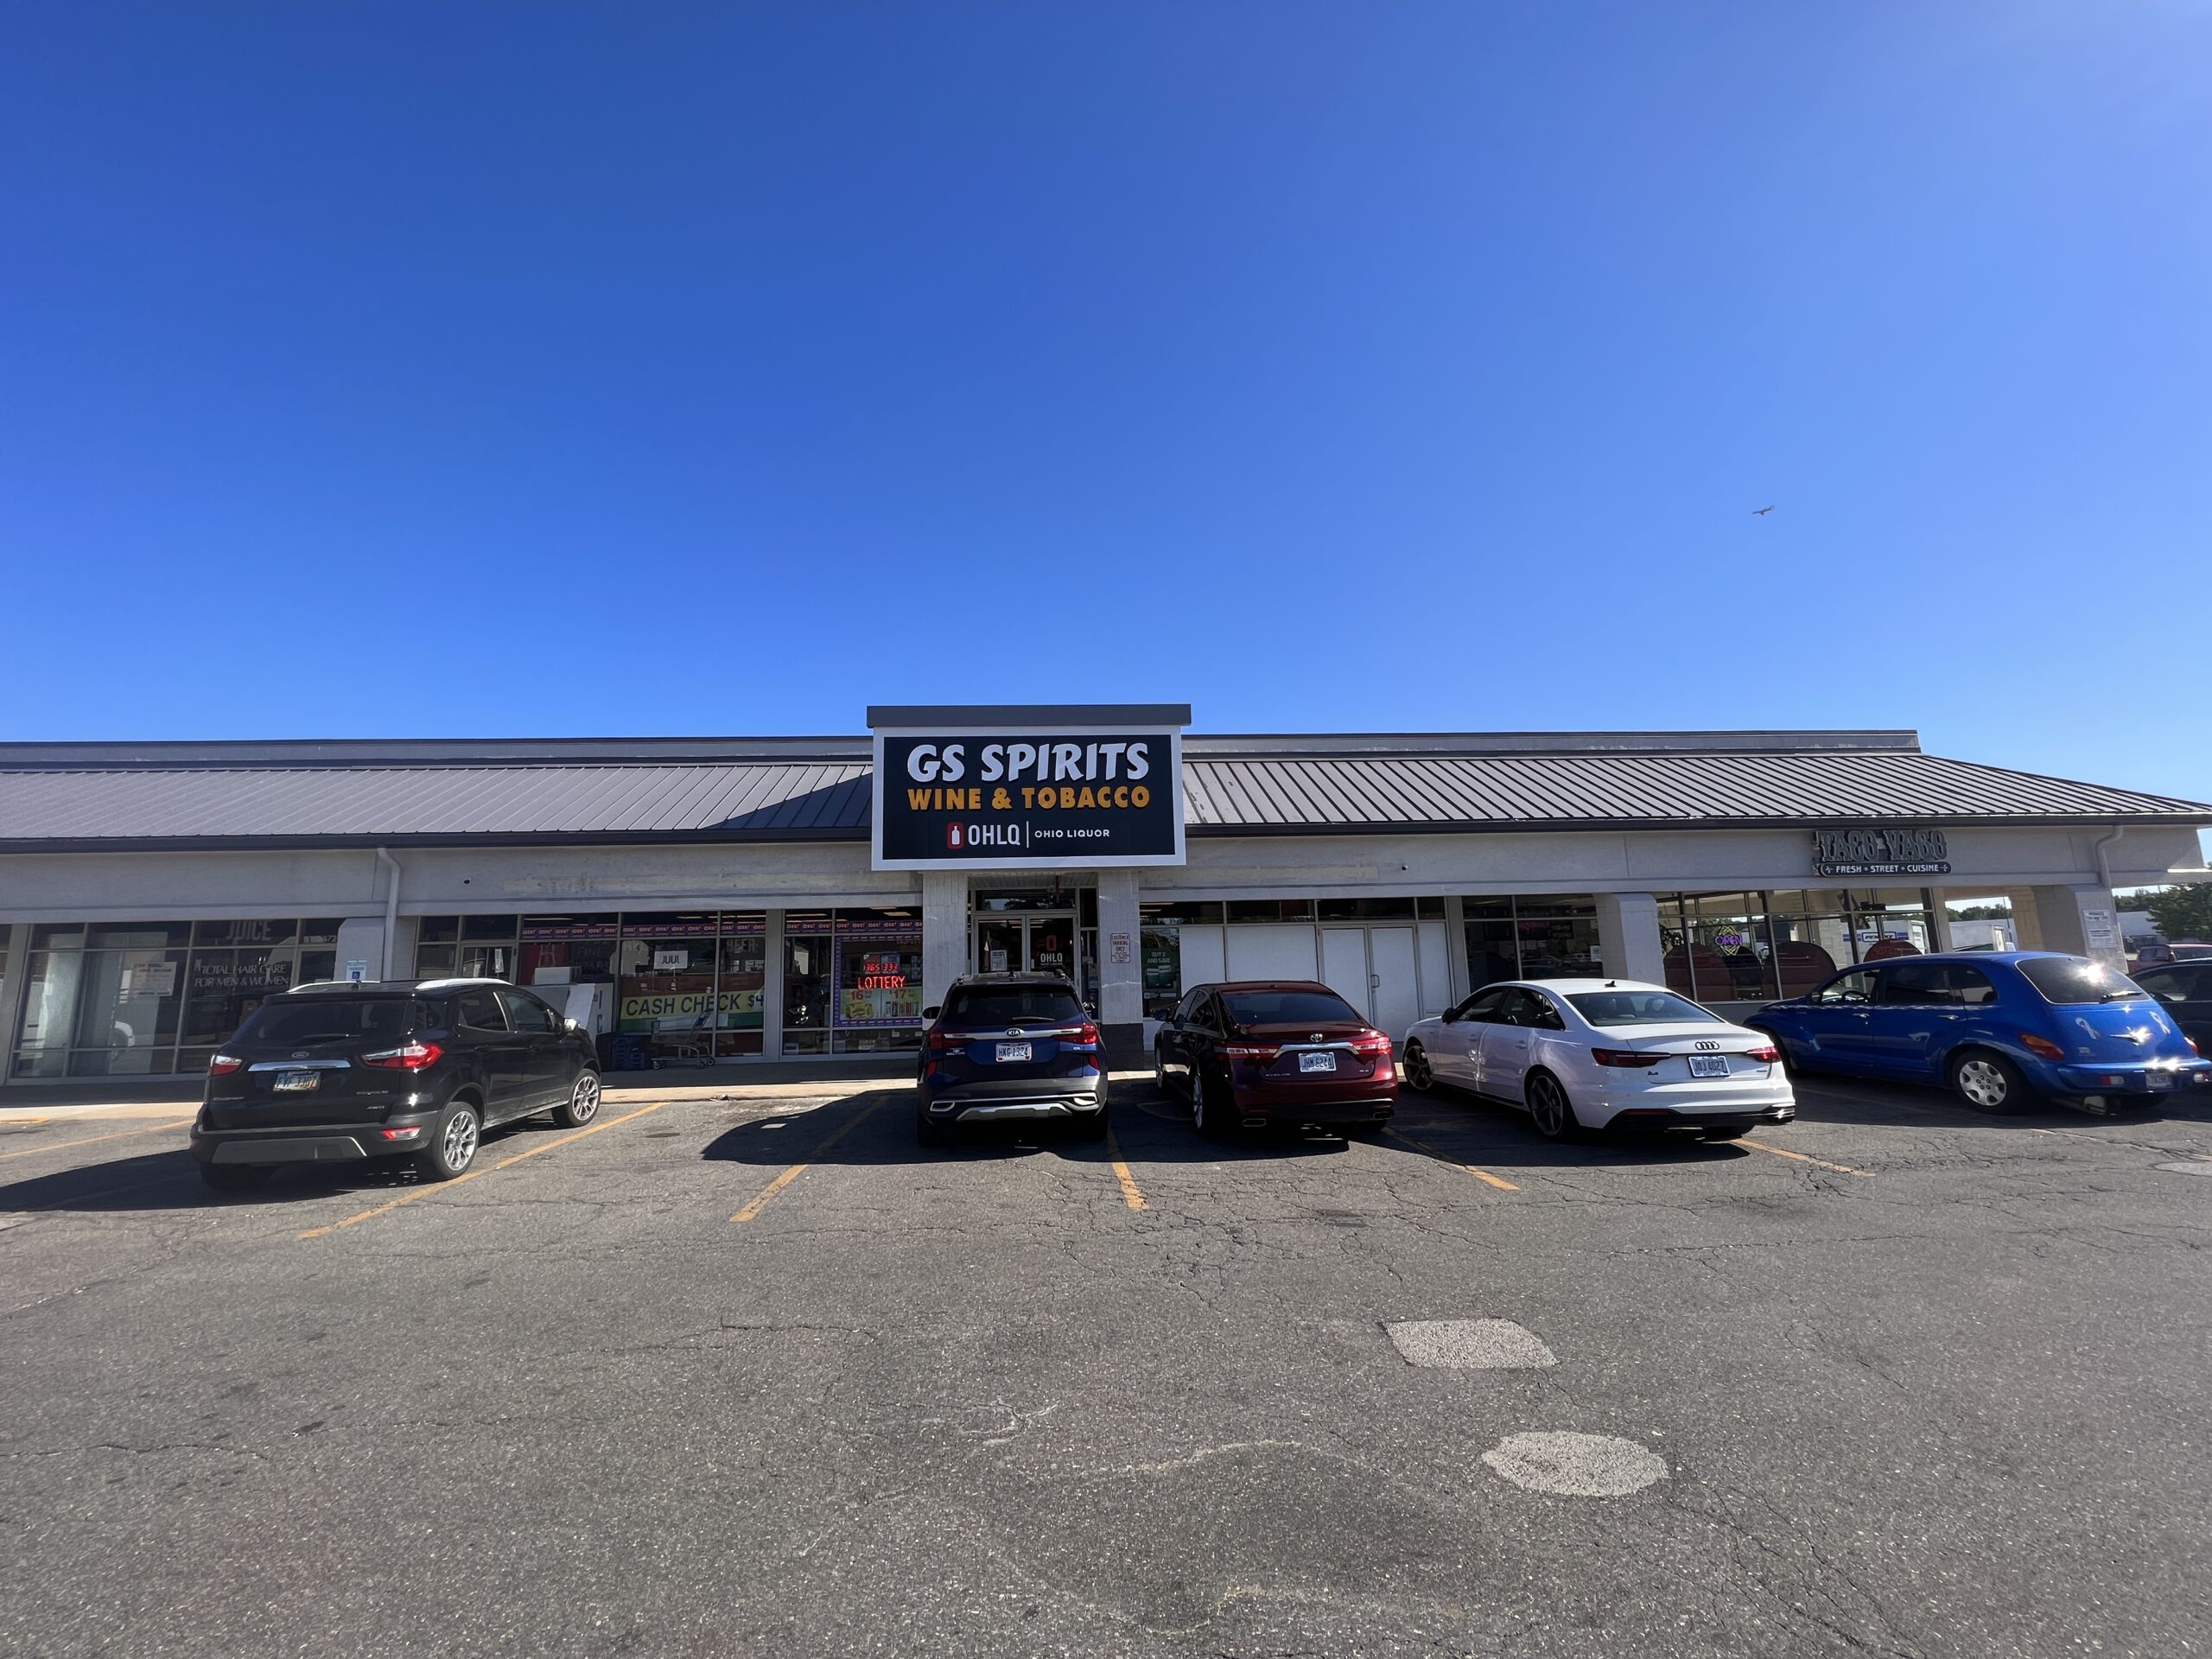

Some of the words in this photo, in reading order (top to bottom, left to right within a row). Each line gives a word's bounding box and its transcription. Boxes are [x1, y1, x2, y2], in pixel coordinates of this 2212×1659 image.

[907, 744, 965, 783] GS
[981, 742, 1150, 783] SPIRITS
[907, 788, 982, 810] WINE
[992, 787, 1013, 809] &
[1021, 785, 1150, 809] TOBACCO
[968, 823, 1020, 847] OHLQ
[1034, 830, 1063, 839] OHIO
[1067, 829, 1110, 838] LIQUOR
[1816, 830, 1878, 861] TACO
[1836, 865, 1862, 874] FRESH
[1871, 864, 1899, 873] STREET
[226, 919, 271, 941] JUICE
[1714, 935, 1742, 946] OPEN
[1040, 952, 1064, 963] OHLQ
[200, 964, 231, 975] TOTAL
[858, 976, 906, 989] LOTTERY
[626, 998, 676, 1016] CASH
[681, 994, 742, 1013] CHECK
